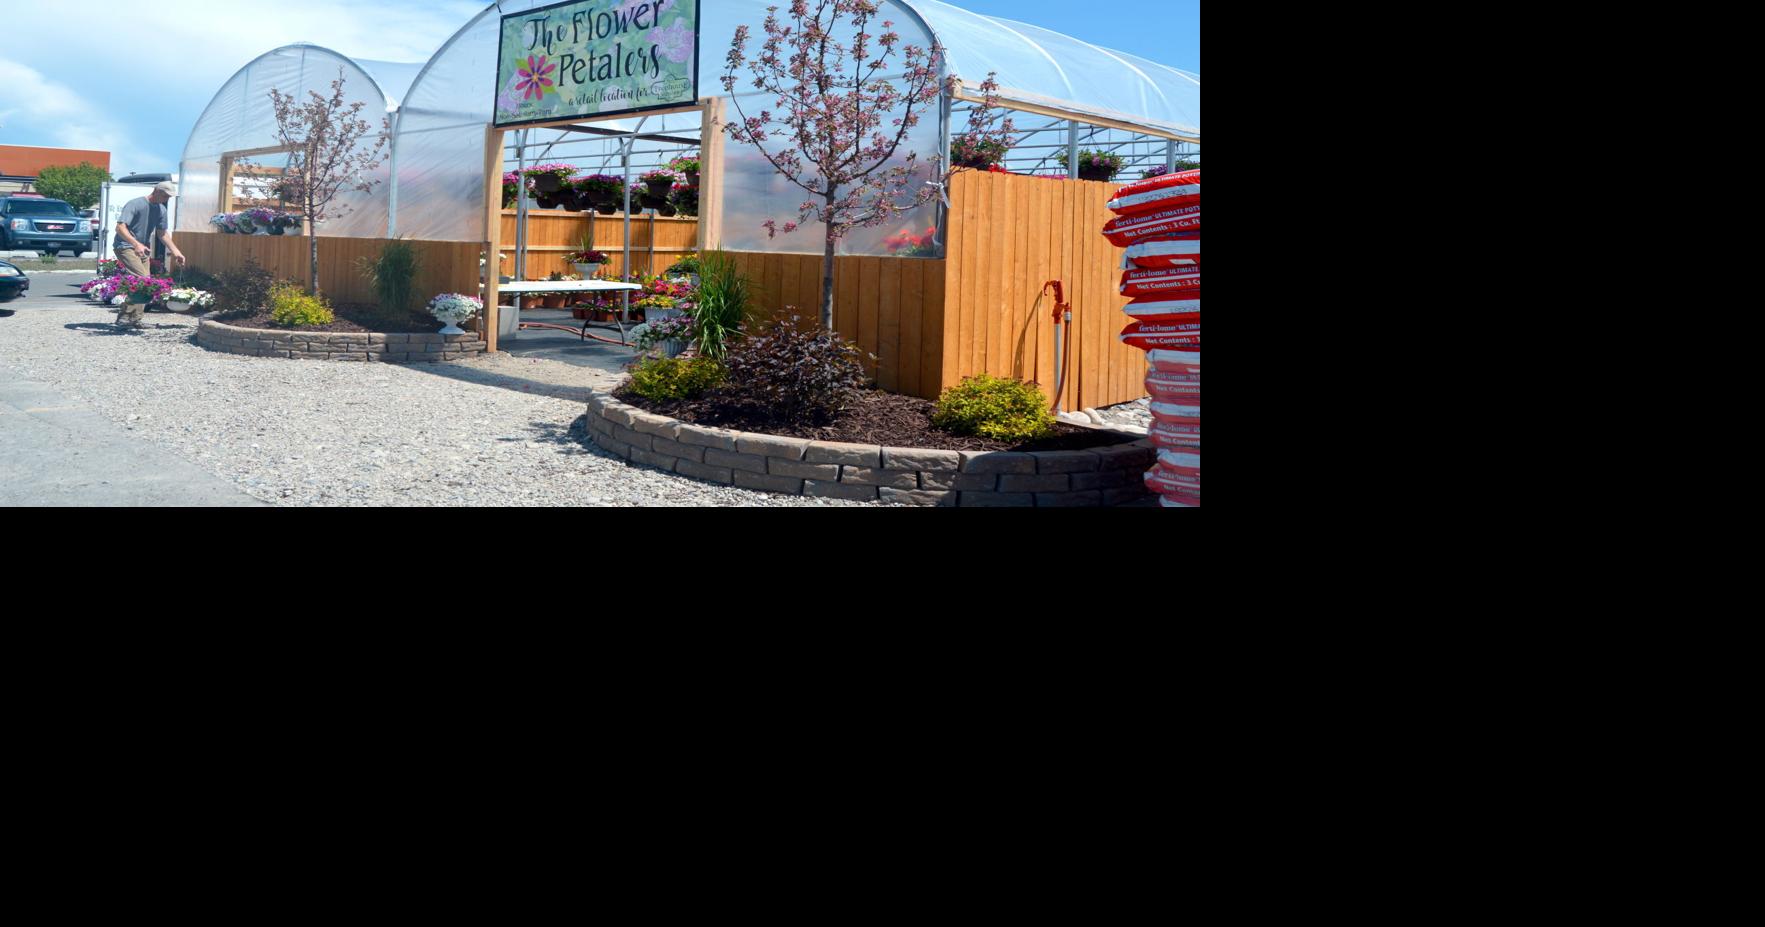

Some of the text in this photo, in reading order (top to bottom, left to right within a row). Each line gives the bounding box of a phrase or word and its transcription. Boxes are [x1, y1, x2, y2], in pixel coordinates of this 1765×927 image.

[524, 0, 664, 55] The Flower
[558, 43, 662, 86] Petalers
[568, 98, 574, 106] a
[575, 89, 598, 105] retail
[600, 88, 633, 103] location
[636, 87, 648, 102] for
[1155, 209, 1184, 219] ULTIMATE
[1137, 225, 1168, 235] Contents
[1170, 266, 1198, 275] ULTIMATE
[1151, 281, 1181, 289] Contents
[1159, 336, 1190, 344] Contents
